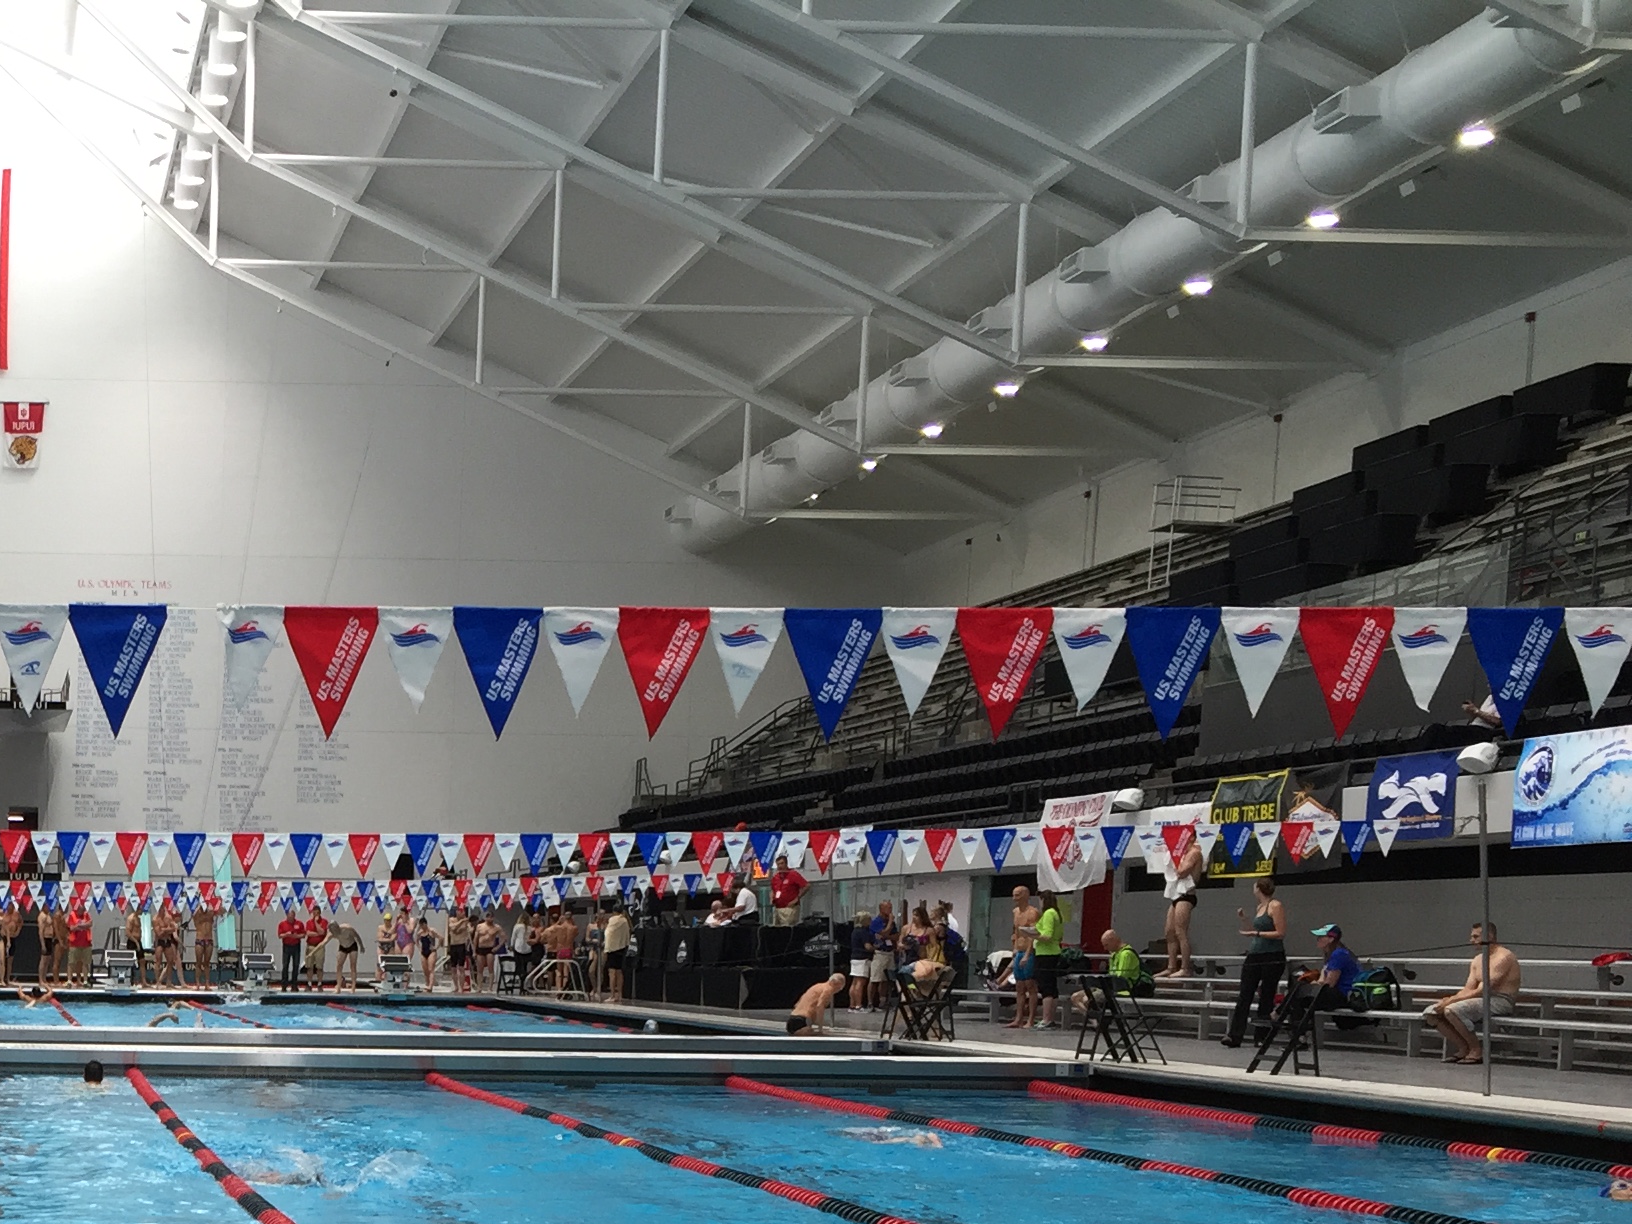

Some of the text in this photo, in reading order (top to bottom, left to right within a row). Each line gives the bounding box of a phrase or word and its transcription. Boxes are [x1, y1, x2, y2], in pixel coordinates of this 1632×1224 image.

[141, 580, 172, 590] TEAMS
[113, 614, 148, 677] MASTERS
[118, 623, 156, 698] SWIMMING
[326, 617, 360, 680] MASTERS
[331, 628, 369, 701] SWIMMING
[496, 618, 530, 680] MASTERS
[501, 626, 537, 701] SWIMMING
[655, 619, 691, 681] MASTERS
[659, 629, 699, 702] SWIMMING
[827, 619, 863, 682] MASTERS
[833, 630, 872, 703] SWIMMING
[997, 618, 1034, 682] MASTERS
[1003, 629, 1043, 702] SWIMMING
[1165, 616, 1202, 679] MASTERS
[1169, 627, 1210, 700] SWIMMING
[1341, 617, 1377, 681] MASTERS
[1346, 627, 1385, 701] SWIMMING
[1510, 617, 1544, 676] MASTERS
[1514, 627, 1553, 700] SWIMMING
[13, 701, 48, 710] IUUI
[1212, 807, 1239, 824] CLUB
